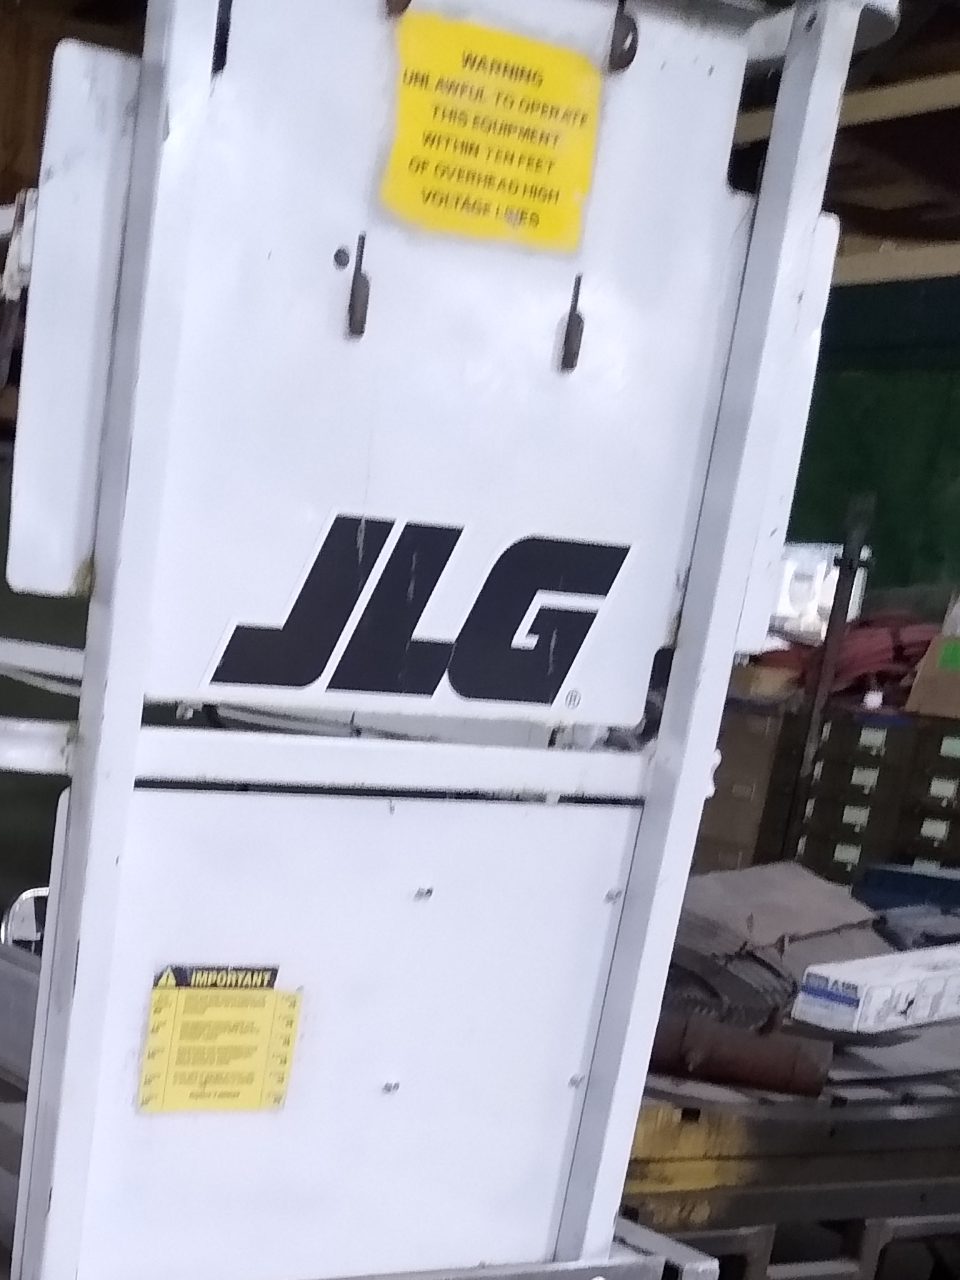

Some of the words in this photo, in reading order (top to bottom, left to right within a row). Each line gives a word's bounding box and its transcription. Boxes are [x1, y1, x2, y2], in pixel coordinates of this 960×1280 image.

[462, 50, 544, 87] WARNING
[403, 69, 485, 101] UNLAWFUL
[495, 92, 515, 110] TO
[519, 99, 589, 128] OPERATE
[432, 103, 468, 127] THIS
[472, 115, 560, 150] EQUIPMENT
[422, 130, 480, 159] WITHIN
[486, 146, 515, 167] TEN
[518, 155, 557, 175] FEET
[408, 155, 430, 175] OF
[434, 163, 520, 196] OVERHEAD
[522, 183, 560, 205] HIGH
[421, 187, 491, 217] VOLTAGE
[208, 513, 632, 709] JLG
[191, 969, 272, 989] IMPORTANT
